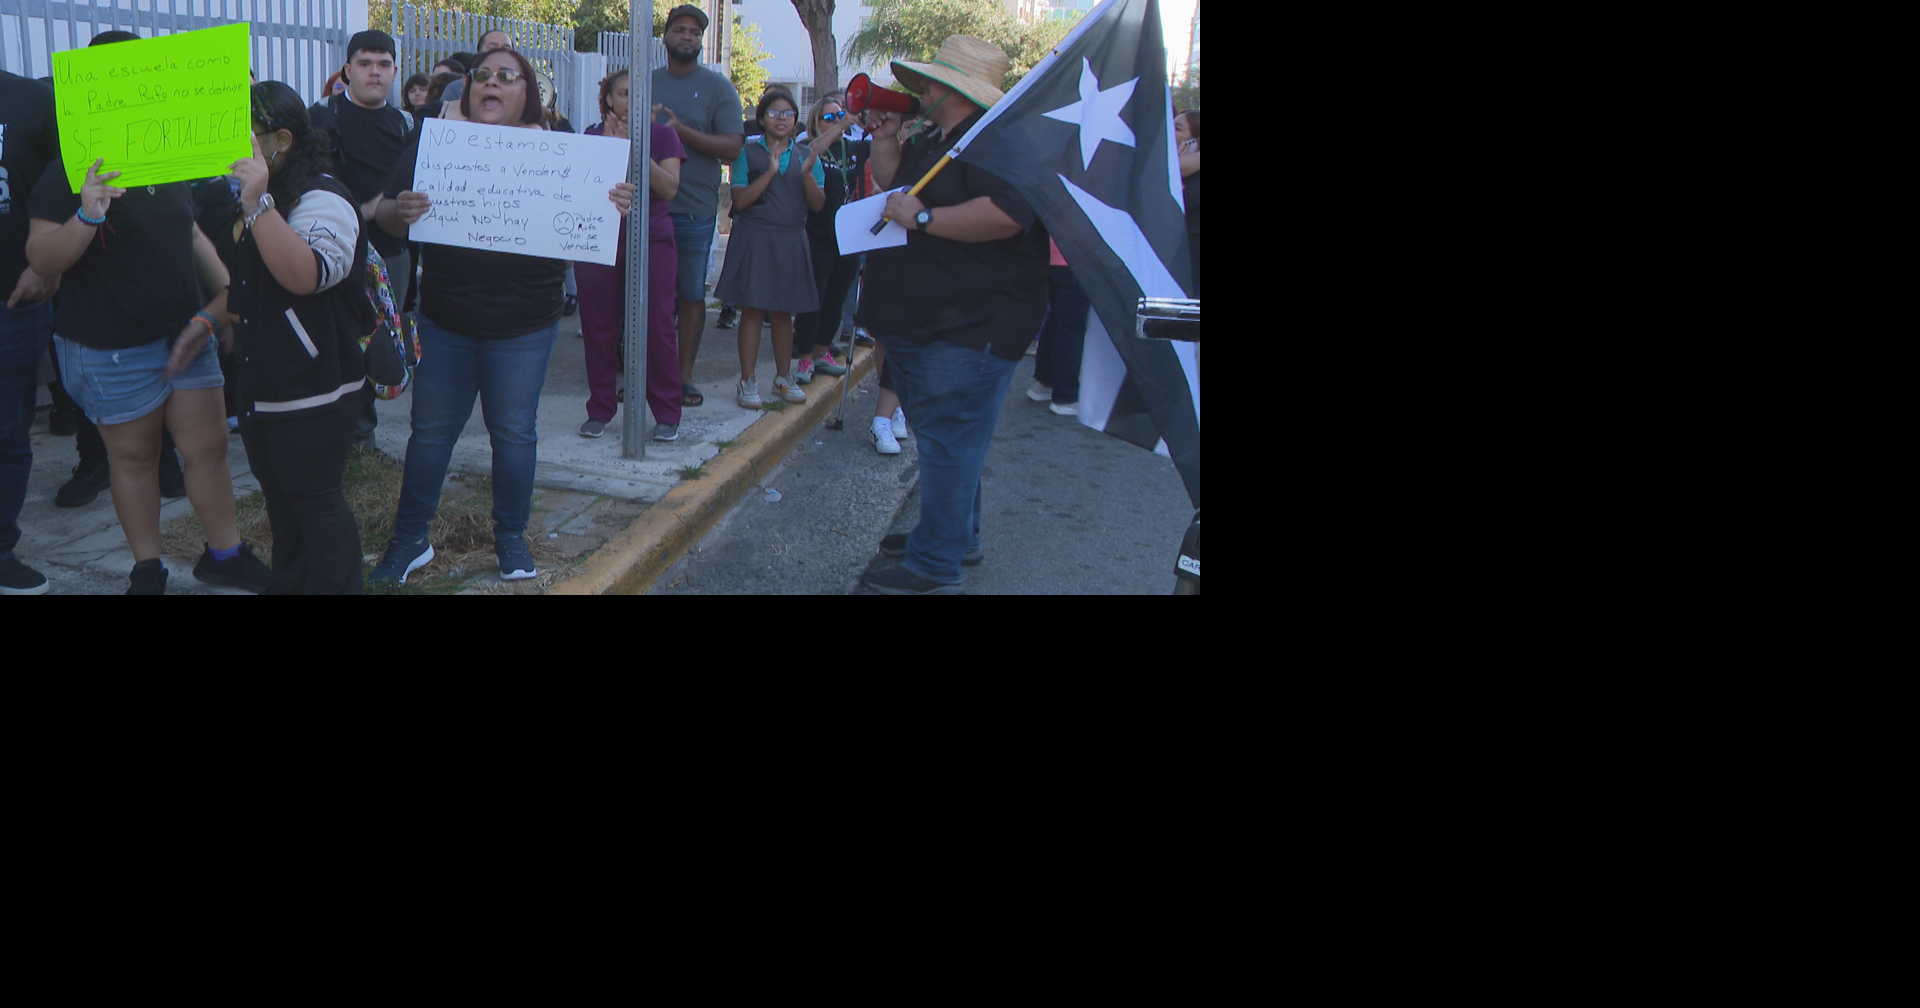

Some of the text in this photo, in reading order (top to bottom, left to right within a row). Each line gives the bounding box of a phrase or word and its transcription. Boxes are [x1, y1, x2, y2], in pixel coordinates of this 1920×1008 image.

[108, 54, 179, 78] escuela
[186, 54, 231, 70] como
[87, 89, 127, 112] Padre
[137, 83, 168, 103] Rufo
[173, 88, 190, 99] no
[193, 86, 206, 96] se
[72, 105, 248, 166] SE FORTALECE!
[429, 126, 568, 157] NO estamos
[499, 165, 507, 175] a
[476, 182, 546, 198] educativa
[552, 185, 573, 203] de
[430, 195, 521, 219] uestros hijos
[573, 211, 605, 224] Padre
[471, 213, 492, 226] NO
[503, 212, 529, 232] hay
[468, 232, 527, 247] Negocio
[558, 239, 601, 253] Vende
